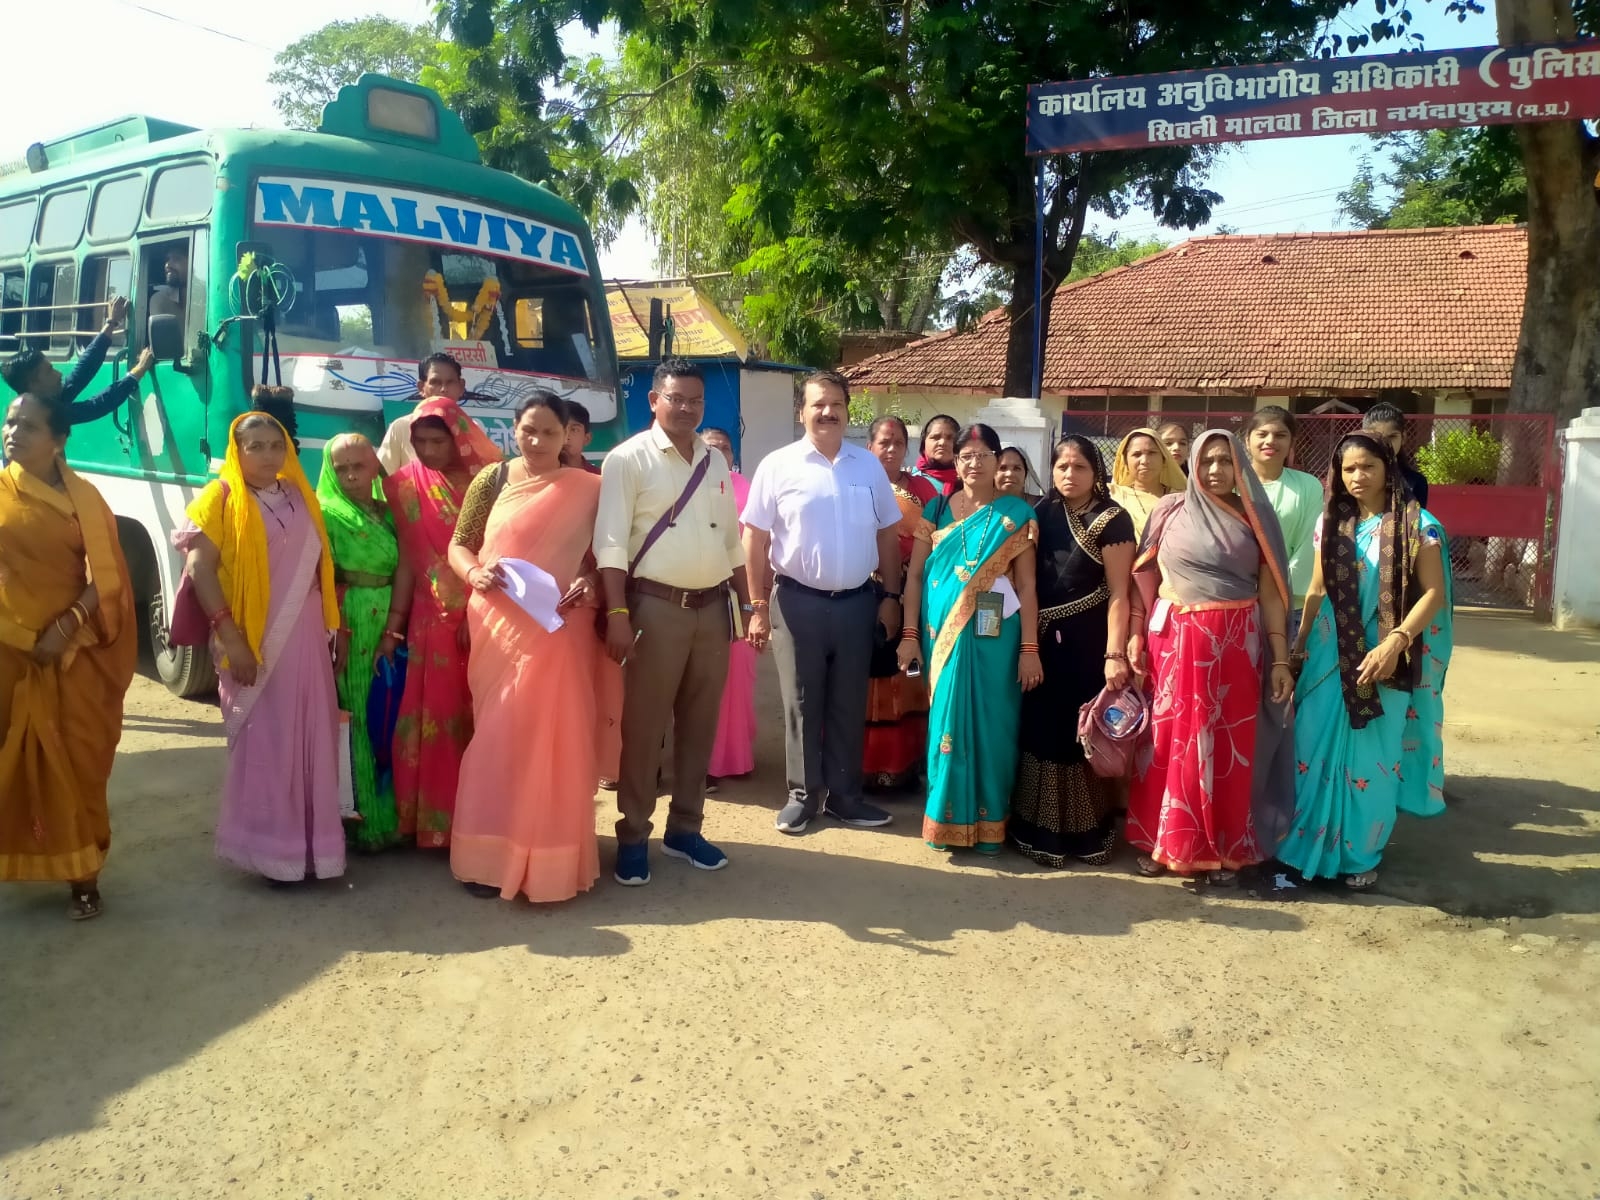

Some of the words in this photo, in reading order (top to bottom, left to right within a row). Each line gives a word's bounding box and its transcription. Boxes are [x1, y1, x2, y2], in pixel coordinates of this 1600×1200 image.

[1038, 84, 1146, 116] कार्यालय
[1157, 68, 1320, 112] अनुविभागीय
[1332, 56, 1460, 94] अधिकारी
[1148, 115, 1217, 142] सिवनी
[1224, 112, 1301, 136] मालवा
[1311, 106, 1377, 131] जिला
[1386, 101, 1512, 124] नर्मदापुरम
[257, 182, 587, 271] MALVIYA
